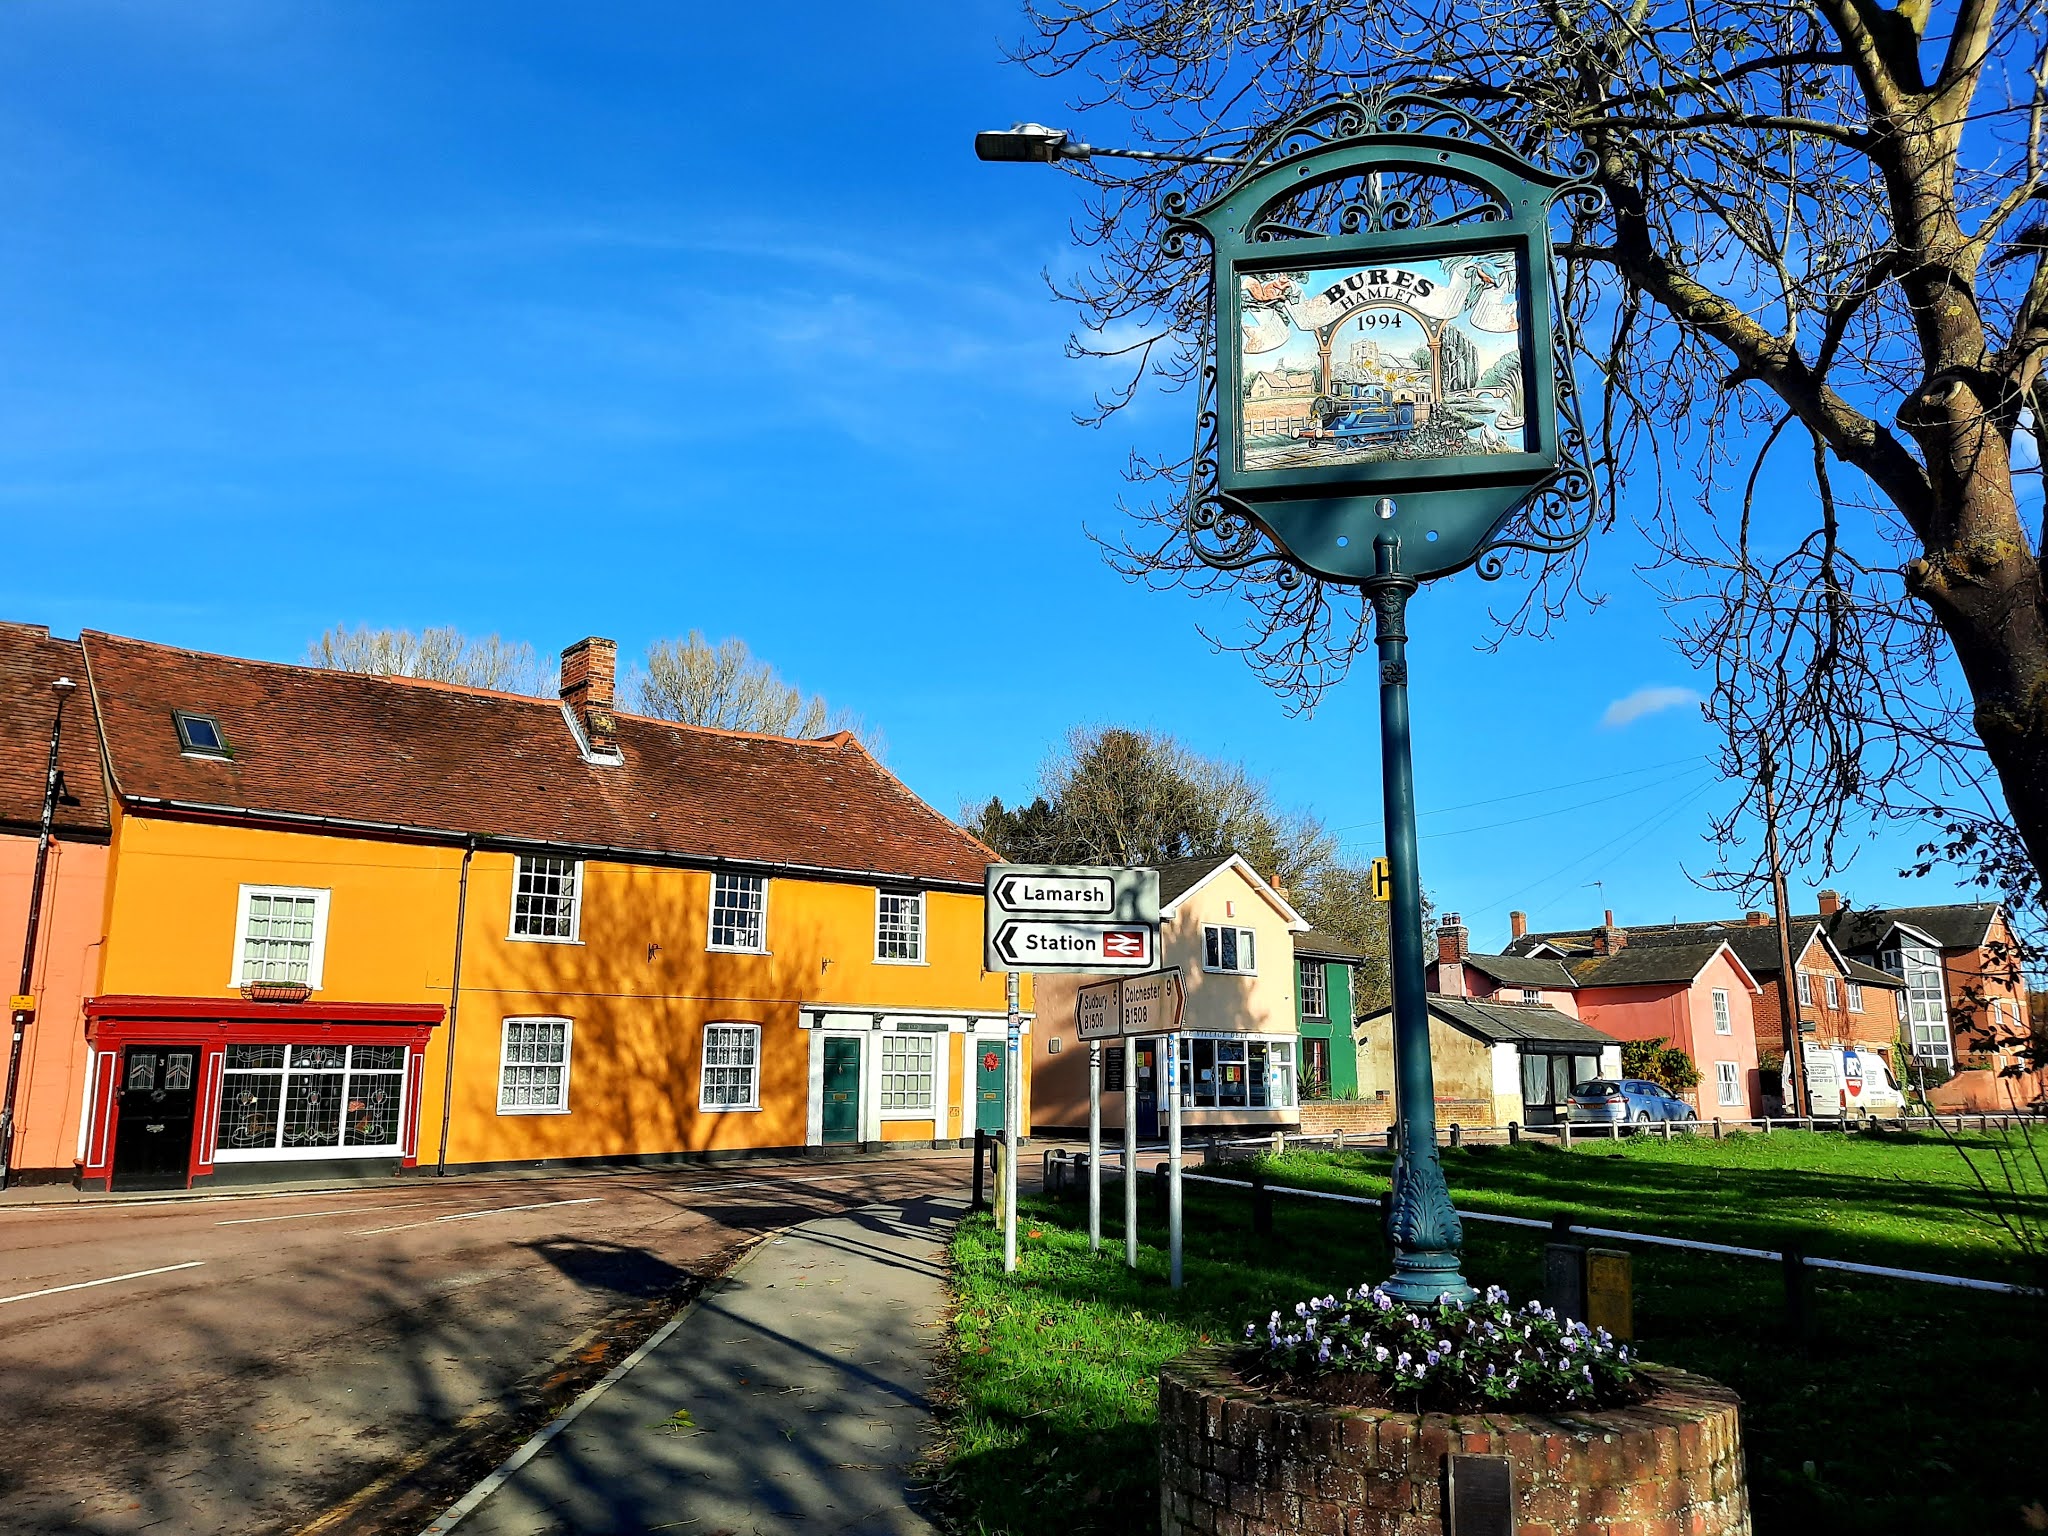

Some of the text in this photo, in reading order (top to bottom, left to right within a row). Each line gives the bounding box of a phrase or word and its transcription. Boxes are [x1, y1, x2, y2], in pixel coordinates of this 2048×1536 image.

[1322, 269, 1435, 305] BURES
[1340, 286, 1417, 310] HAMLET
[1357, 312, 1402, 331] 1994
[1024, 885, 1104, 902] Lamarsh
[1025, 934, 1096, 951] Station
[1084, 989, 1117, 1010] Sudbury 5
[1124, 979, 1172, 1004] Colchester 9
[1084, 1012, 1104, 1030] B1508
[1125, 1005, 1148, 1025] B1508
[159, 1059, 165, 1067] 3
